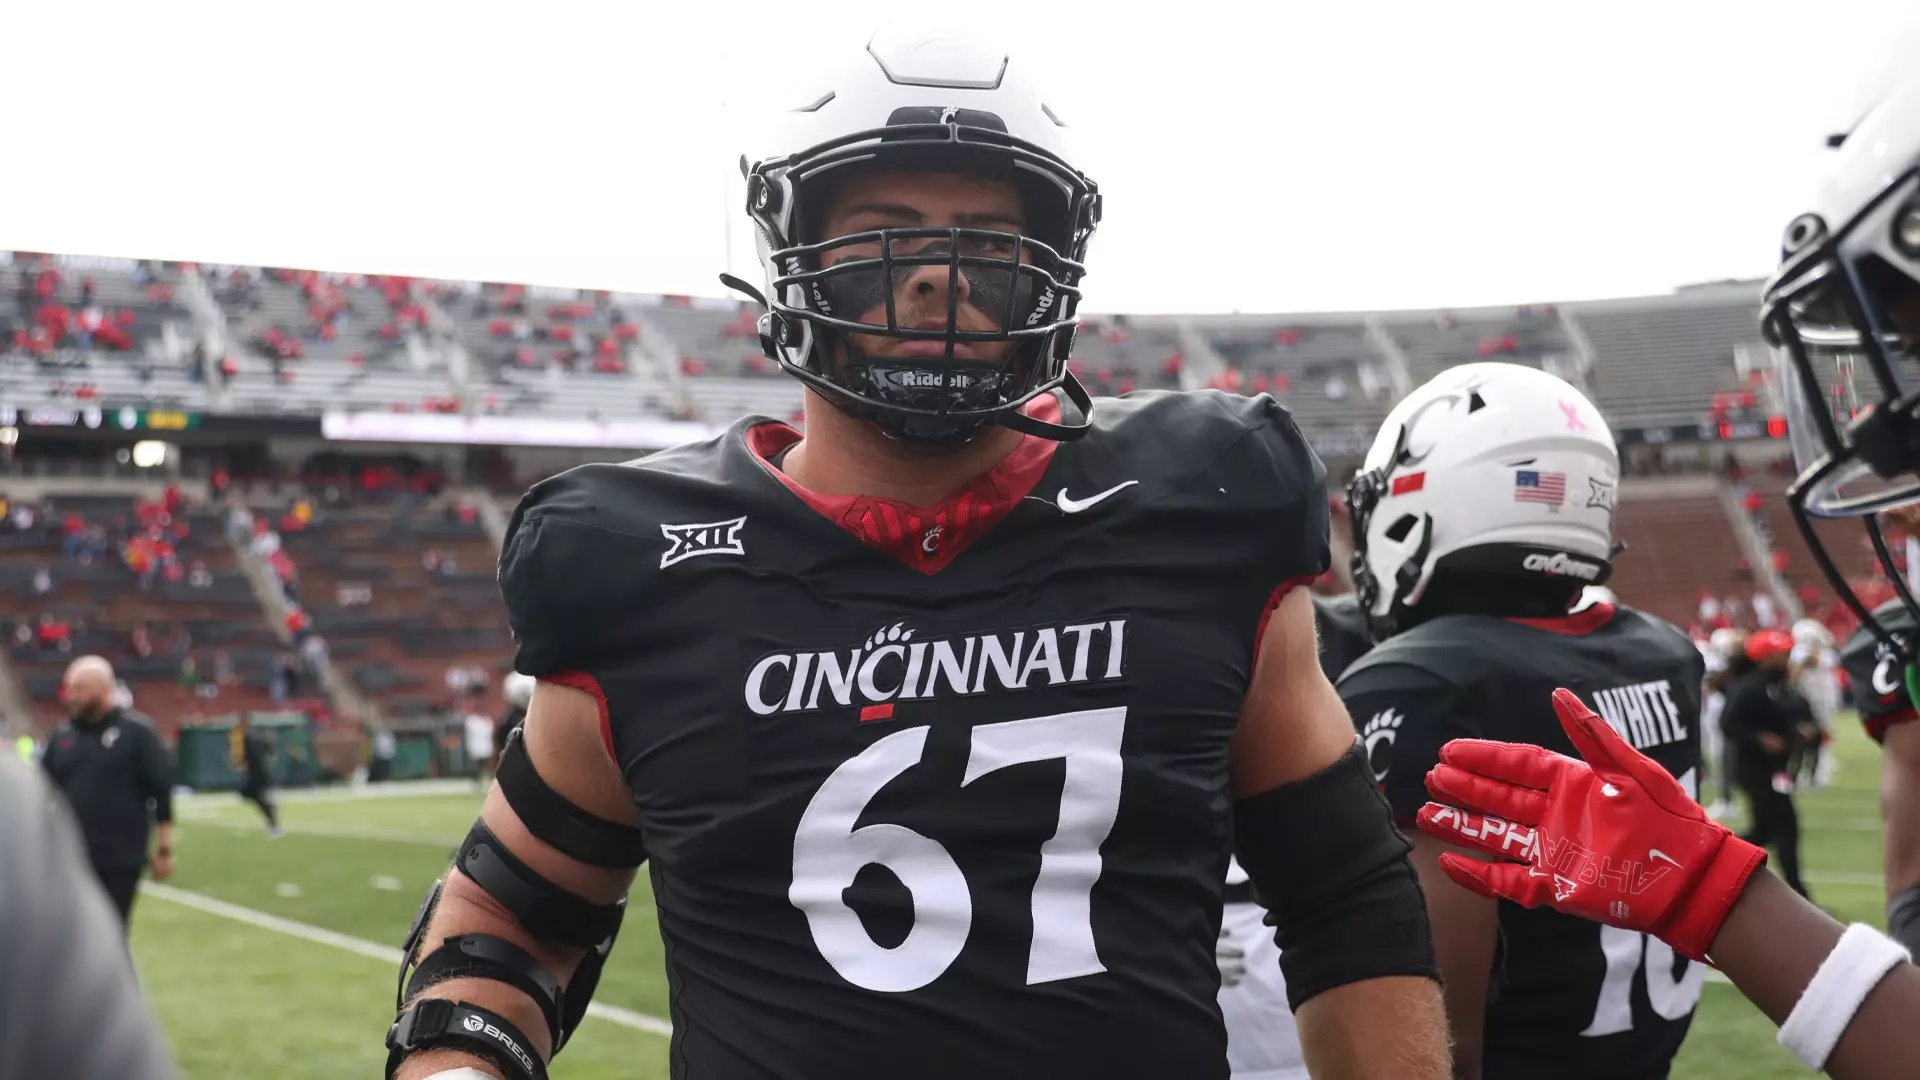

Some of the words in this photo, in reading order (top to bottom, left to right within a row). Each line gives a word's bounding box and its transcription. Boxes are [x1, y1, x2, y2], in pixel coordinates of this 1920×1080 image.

[1026, 285, 1055, 326] Ridd
[744, 620, 1127, 716] CINCINNATI
[1592, 680, 1688, 749] WHITE
[788, 706, 1128, 992] 67
[1431, 807, 1541, 867] ALPHA
[483, 1024, 533, 1072] BREG
